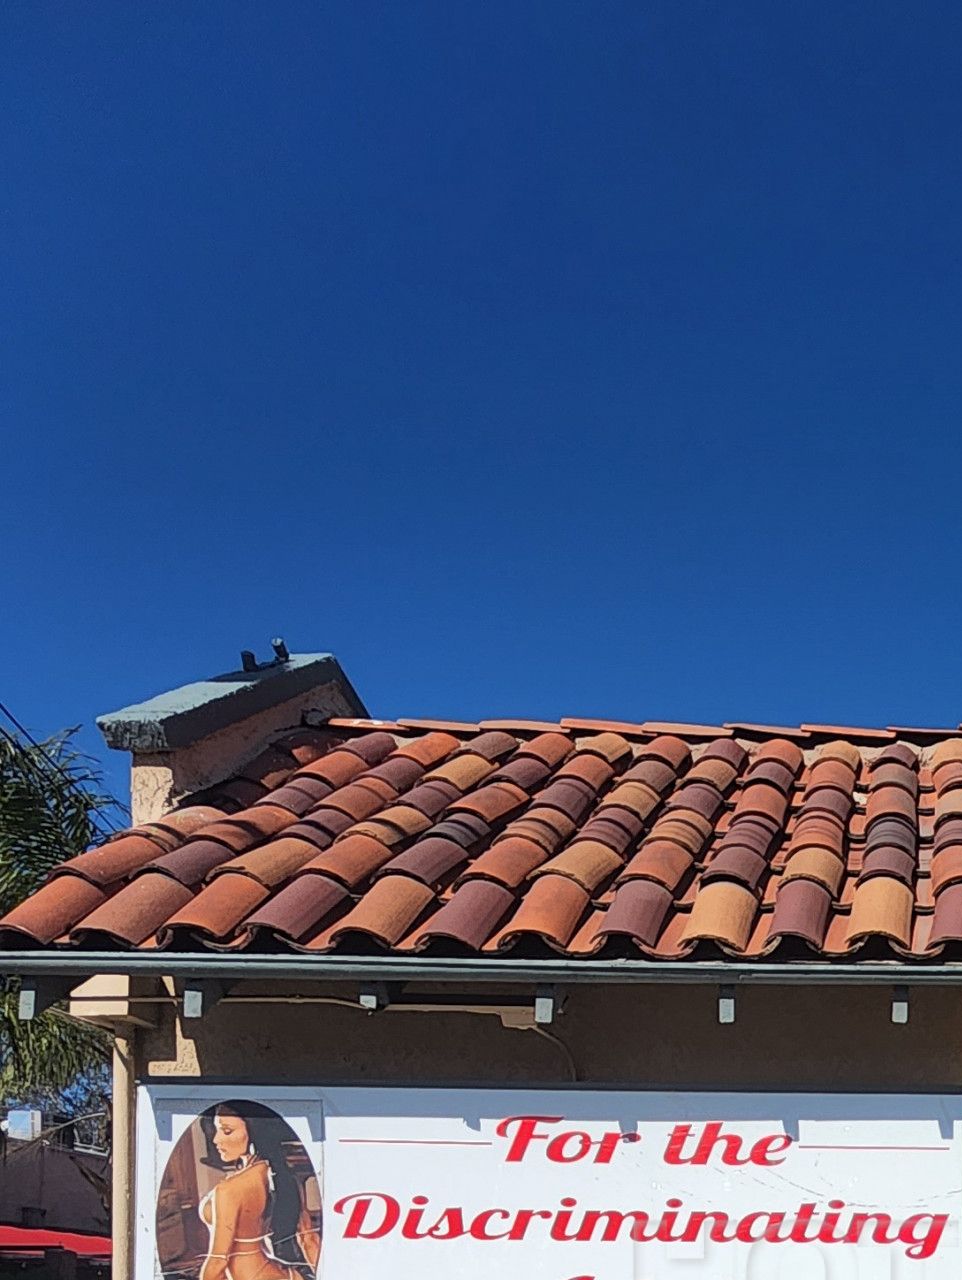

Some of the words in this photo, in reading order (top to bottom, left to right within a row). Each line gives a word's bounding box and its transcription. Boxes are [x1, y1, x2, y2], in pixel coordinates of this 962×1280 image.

[496, 1115, 641, 1163] For
[663, 1121, 793, 1166] the
[332, 1192, 949, 1260] Discriminating
